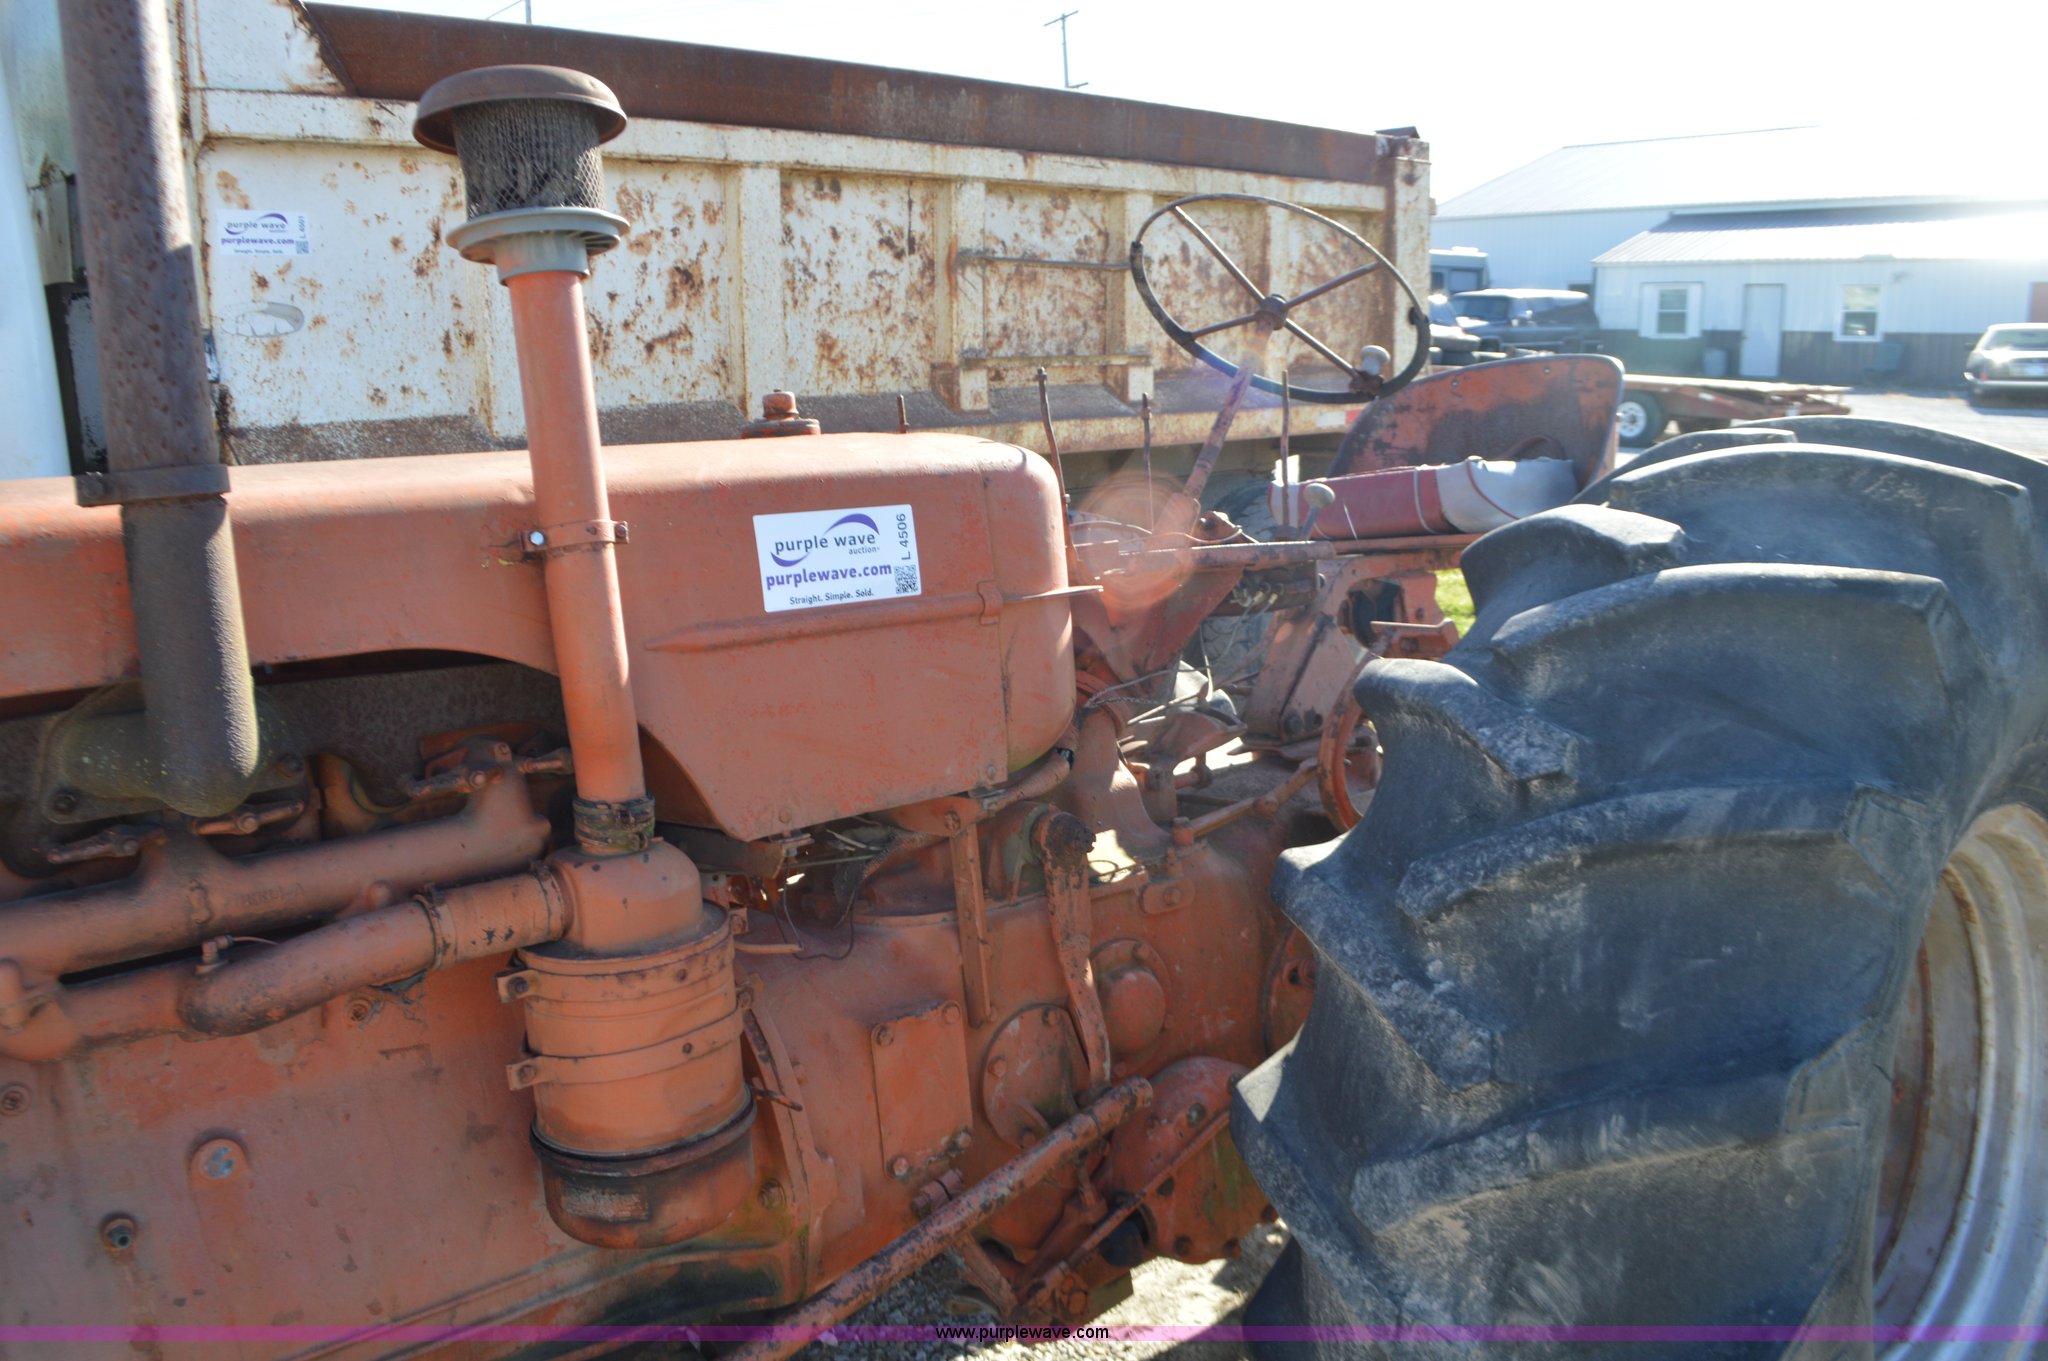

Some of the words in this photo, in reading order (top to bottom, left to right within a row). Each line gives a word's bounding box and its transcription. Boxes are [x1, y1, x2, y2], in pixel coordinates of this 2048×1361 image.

[227, 221, 258, 230] purple
[221, 236, 294, 245] purplewave.com
[896, 513, 909, 548] 4506
[775, 535, 829, 555] purple
[834, 533, 876, 547] wave
[849, 547, 877, 555] auction
[901, 551, 911, 560] L
[766, 564, 892, 590] purplewave.com
[789, 595, 823, 605] Straight.
[825, 591, 853, 602] Simple.
[856, 588, 874, 598] Sold.
